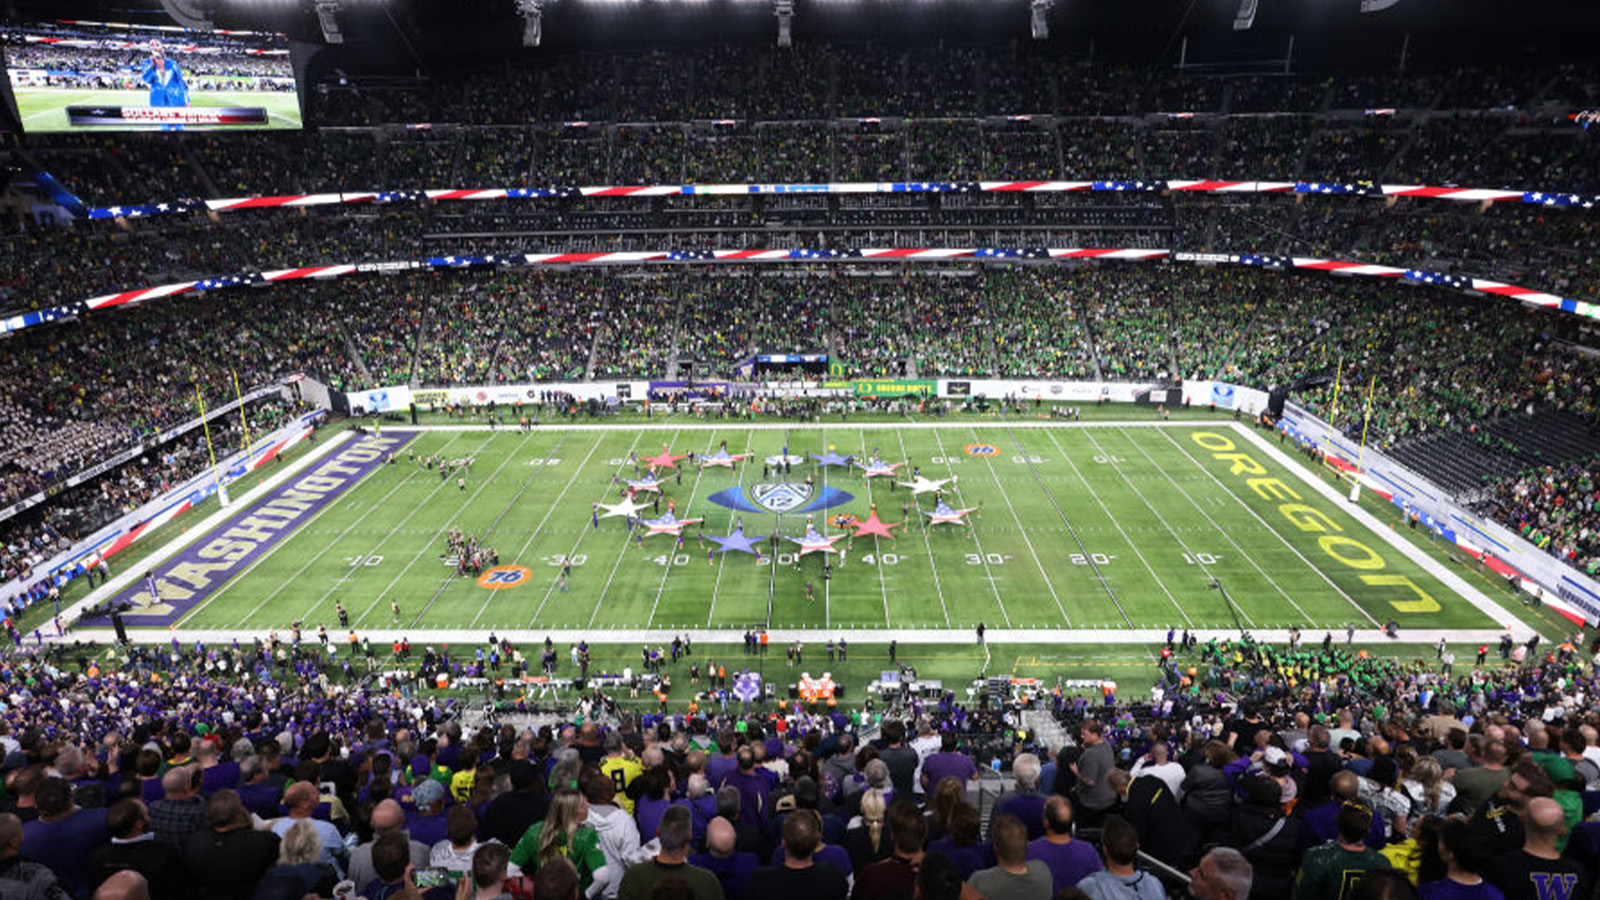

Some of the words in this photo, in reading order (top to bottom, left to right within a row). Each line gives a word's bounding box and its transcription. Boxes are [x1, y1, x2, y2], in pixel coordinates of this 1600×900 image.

[119, 432, 399, 615] WASHINGTON
[1191, 432, 1442, 612] OREGON
[347, 555, 384, 566] 10
[548, 554, 587, 566] 30
[653, 554, 690, 566] 40
[861, 554, 899, 565] 40
[964, 553, 1004, 565] 30
[1068, 553, 1110, 565] 20
[1181, 552, 1217, 565] 10
[483, 569, 525, 583] 76
[611, 768, 626, 793] 8
[1529, 872, 1578, 900] W
